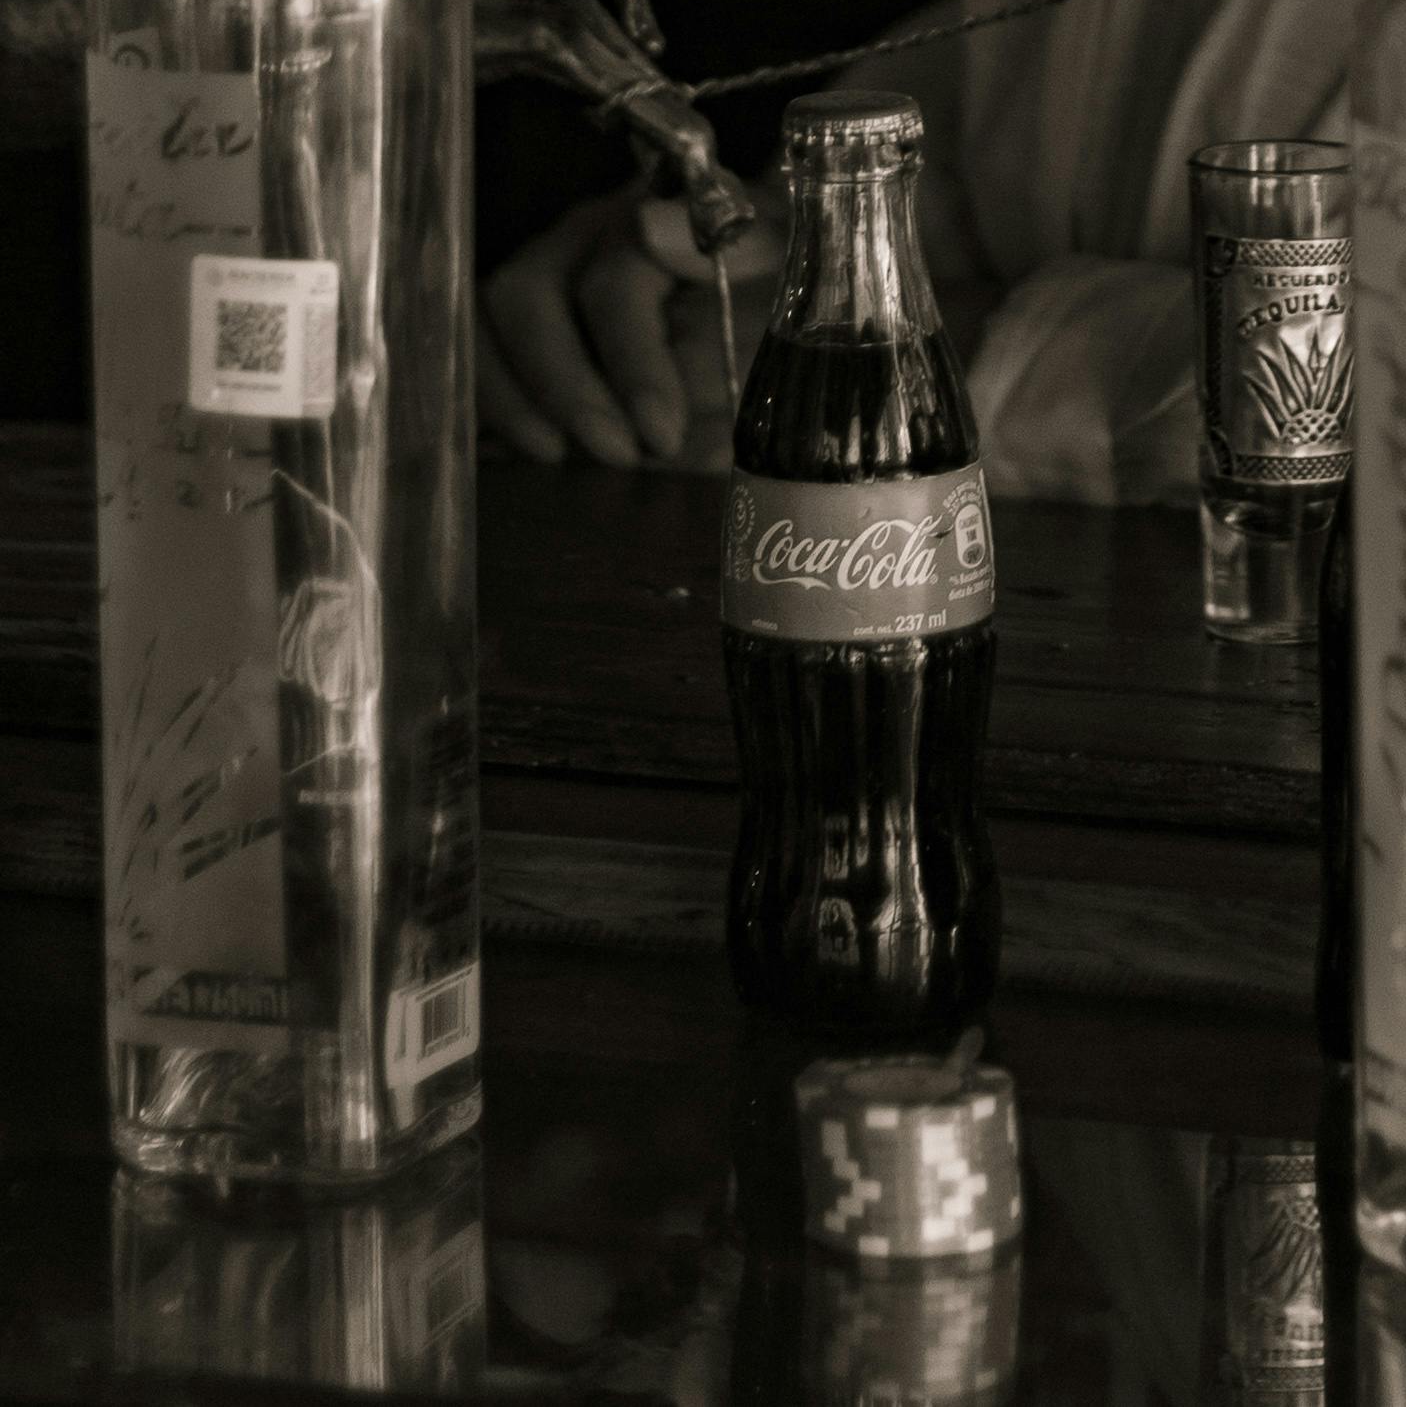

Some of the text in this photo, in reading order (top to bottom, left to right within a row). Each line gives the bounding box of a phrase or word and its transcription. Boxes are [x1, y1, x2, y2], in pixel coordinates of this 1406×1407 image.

[1239, 292, 1341, 336] TEQUILA
[752, 515, 945, 591] Coca-Cola
[895, 613, 925, 633] 237
[928, 608, 947, 628] ml
